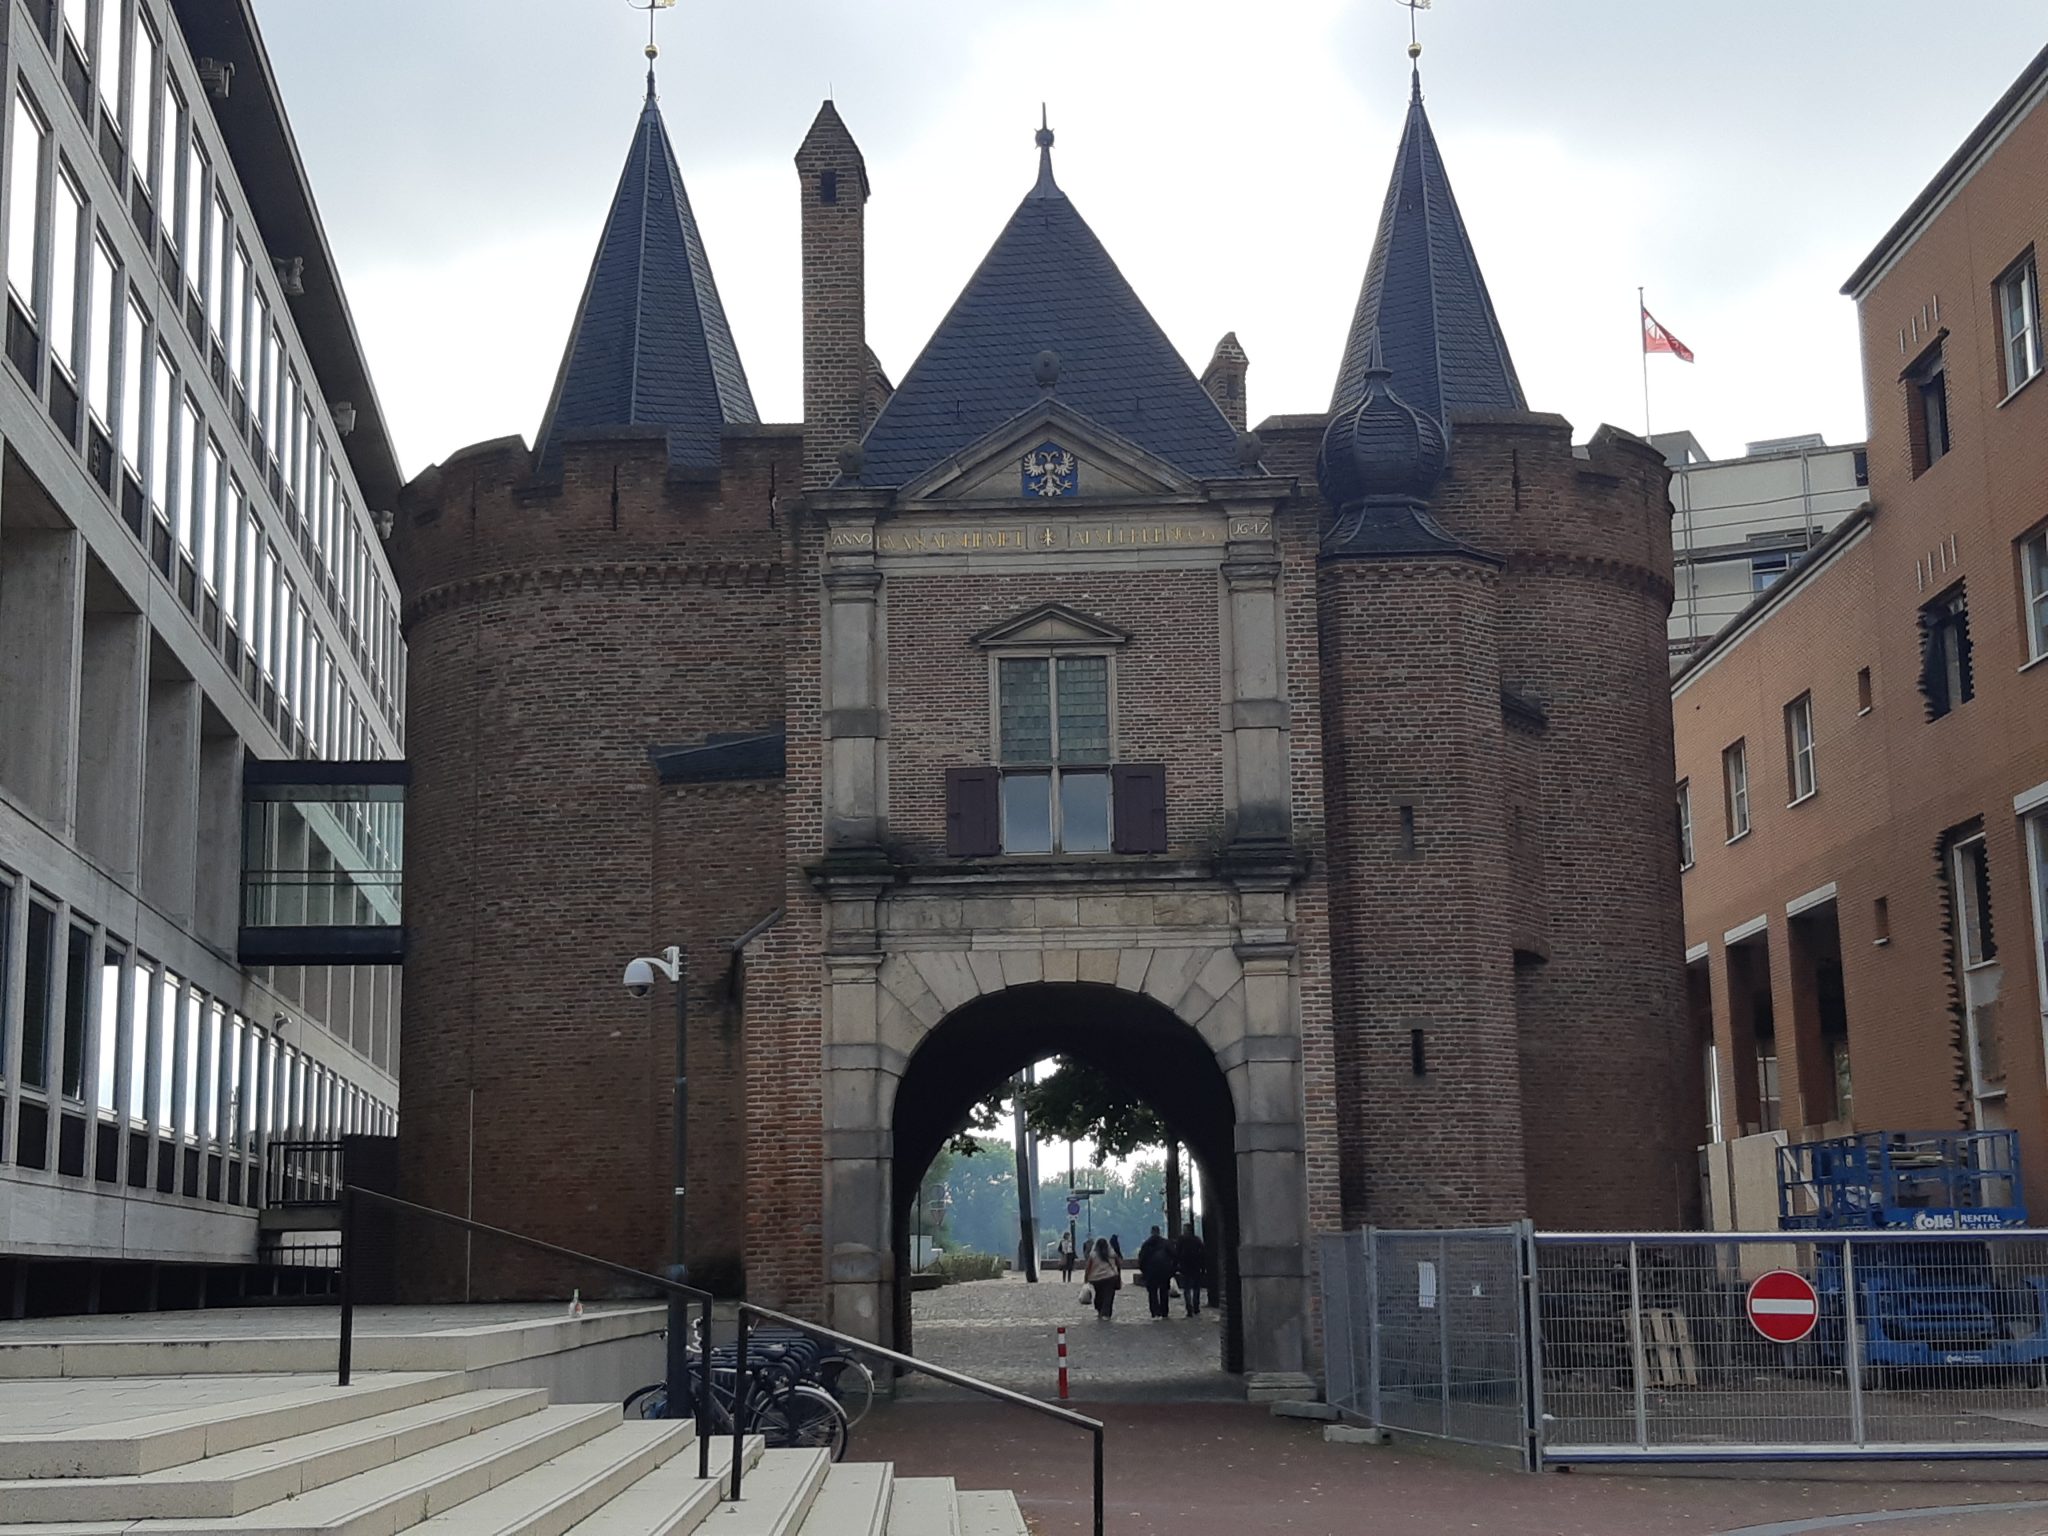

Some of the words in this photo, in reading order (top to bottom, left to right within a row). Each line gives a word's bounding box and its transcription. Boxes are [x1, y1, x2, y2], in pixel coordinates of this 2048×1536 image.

[833, 532, 872, 545] ANNO
[1915, 1213, 1953, 1230] Collé
[1961, 1214, 2001, 1223] RENTAL
